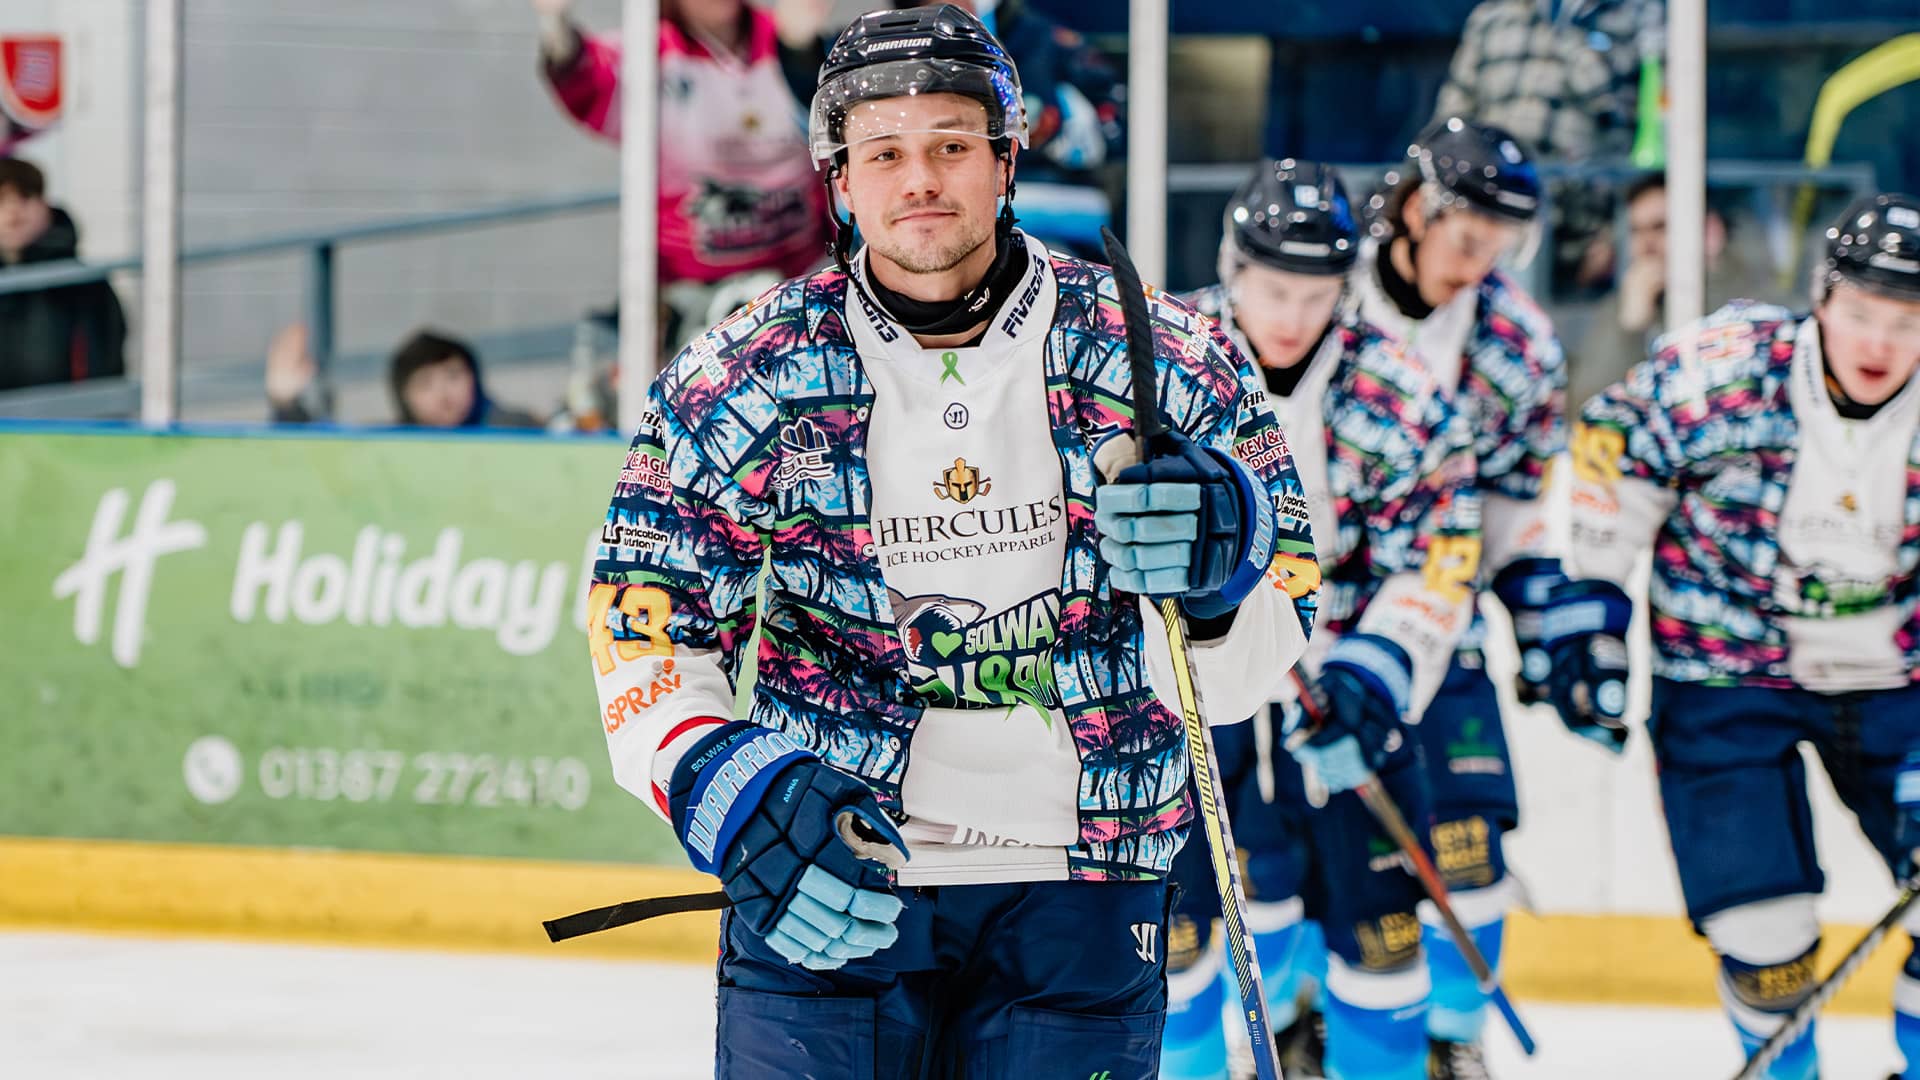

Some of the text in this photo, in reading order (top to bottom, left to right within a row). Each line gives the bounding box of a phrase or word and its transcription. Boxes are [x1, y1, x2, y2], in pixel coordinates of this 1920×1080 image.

[866, 37, 932, 53] WARRIOR
[1237, 436, 1263, 458] KEY
[1266, 431, 1279, 444] &
[877, 495, 1062, 548] HERCULES
[887, 531, 1056, 567] ICE HOCKEY APPAREL
[230, 520, 571, 656] Holiday
[588, 583, 675, 677] 43
[691, 738, 728, 773] SOLWAY
[1184, 708, 1216, 818] WARRIOR
